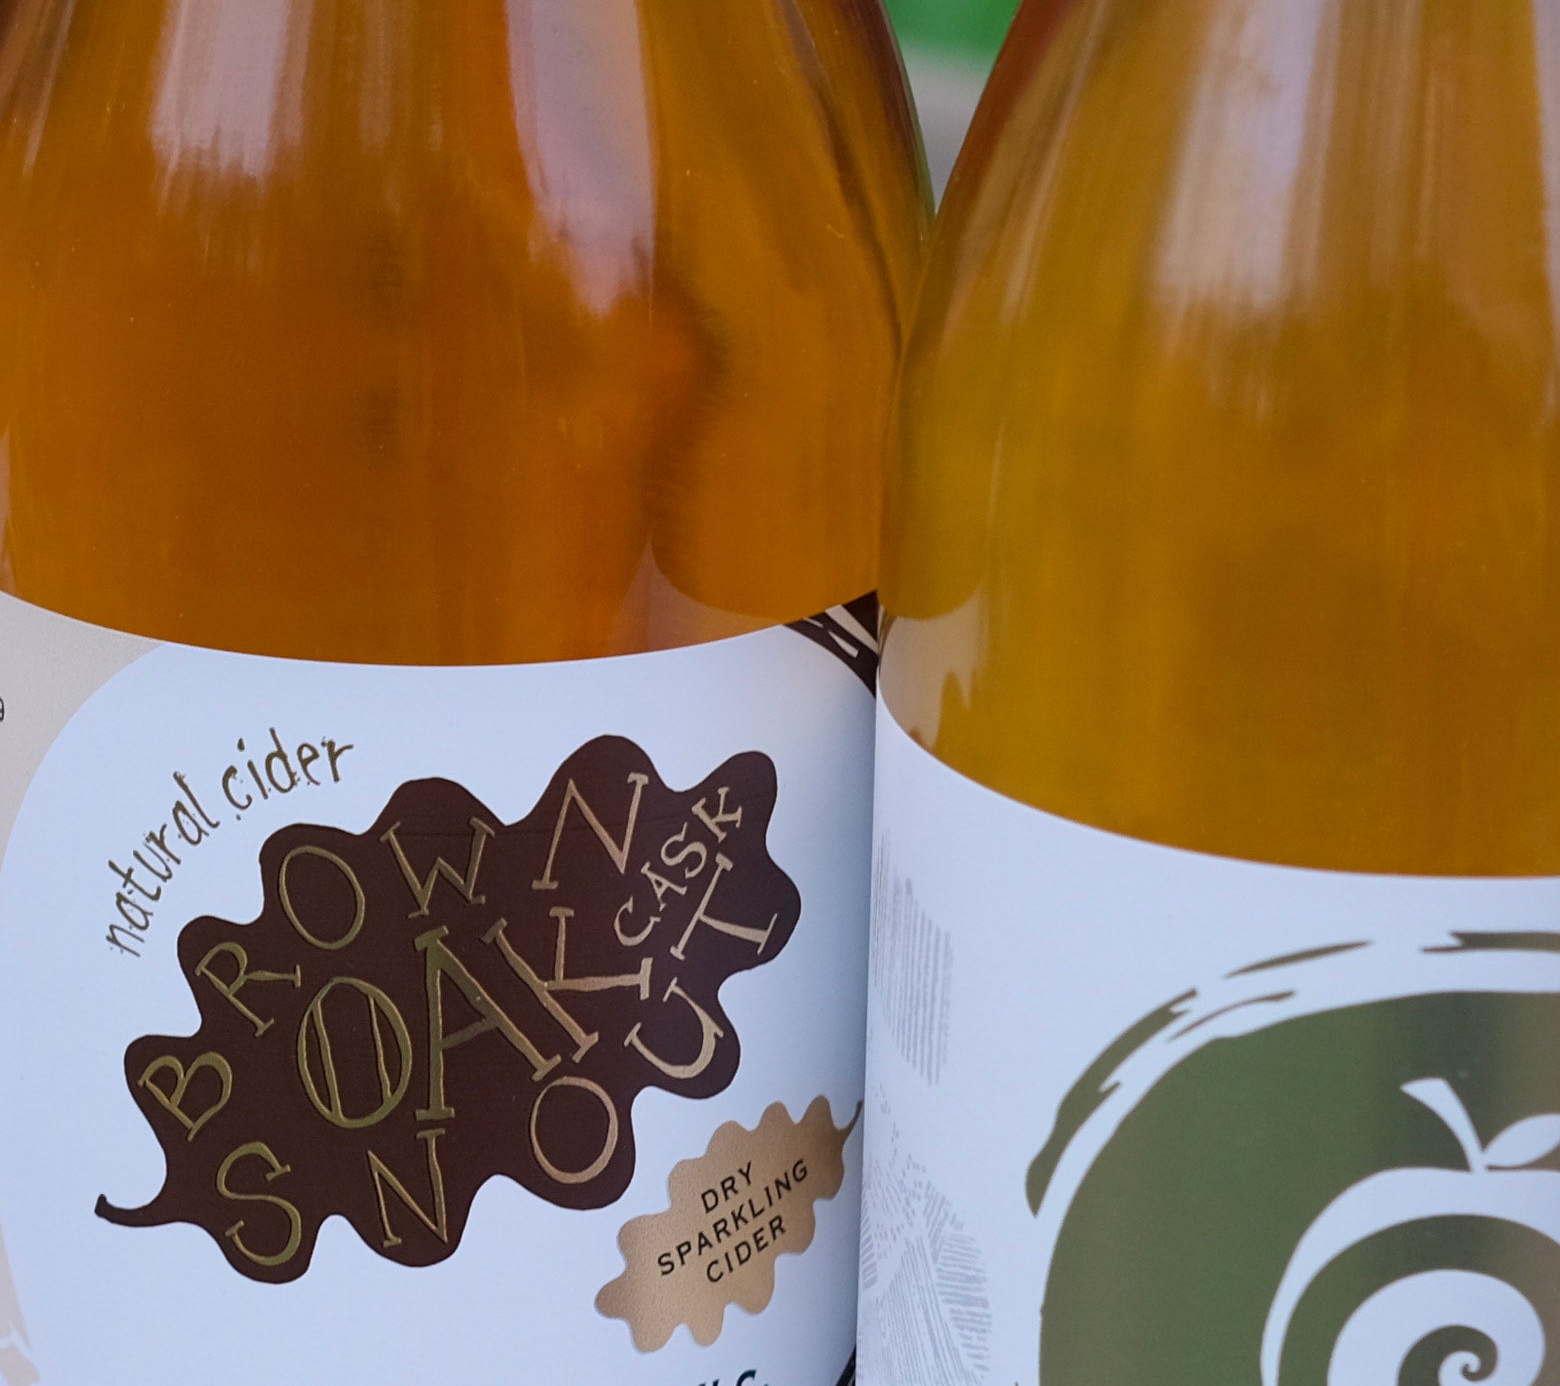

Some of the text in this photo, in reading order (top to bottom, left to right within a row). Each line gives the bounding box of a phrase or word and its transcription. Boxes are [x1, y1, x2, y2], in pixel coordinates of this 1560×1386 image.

[106, 726, 353, 957] natural cider
[297, 786, 743, 1129] OAK CASK
[657, 1158, 809, 1277] SPARKLING
[700, 1161, 753, 1214] DRY
[706, 1215, 787, 1283] CIDER
